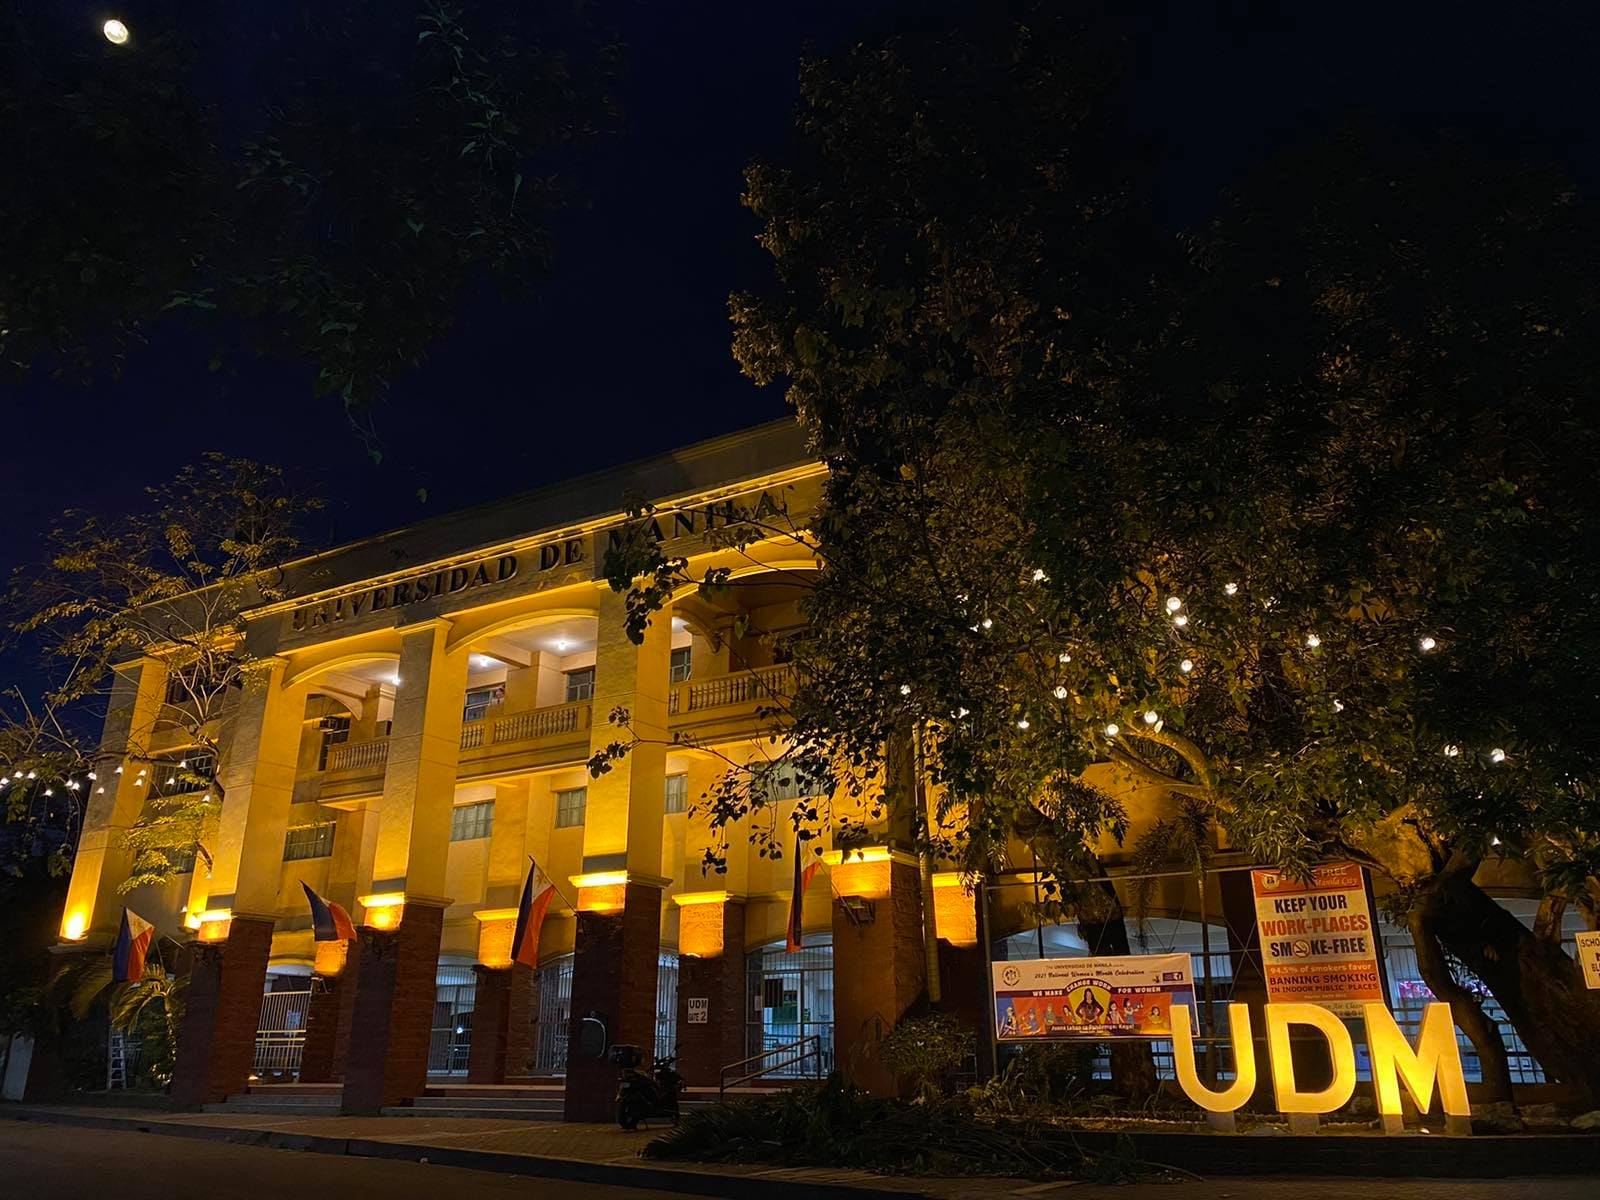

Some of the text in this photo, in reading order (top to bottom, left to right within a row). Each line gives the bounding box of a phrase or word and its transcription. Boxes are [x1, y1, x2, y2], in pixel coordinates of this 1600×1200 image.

[291, 555, 518, 632] UNIVERSIDAD
[537, 538, 585, 573] DE
[1274, 894, 1348, 914] KEEP YOUR
[1261, 914, 1369, 937] WORK-PLACES
[1270, 962, 1372, 975] 94.5% of smokers favor
[1066, 979, 1091, 993] CHANGE
[1092, 980, 1112, 992] WORK
[1269, 972, 1377, 986] BANNING SMOKING
[1281, 985, 1313, 993] INDOOR
[1315, 984, 1344, 992] PUBLIC
[1348, 982, 1378, 991] PLACES
[689, 999, 707, 1009] UDM
[700, 1011, 706, 1021] 2
[1169, 1002, 1472, 1117] UDM
